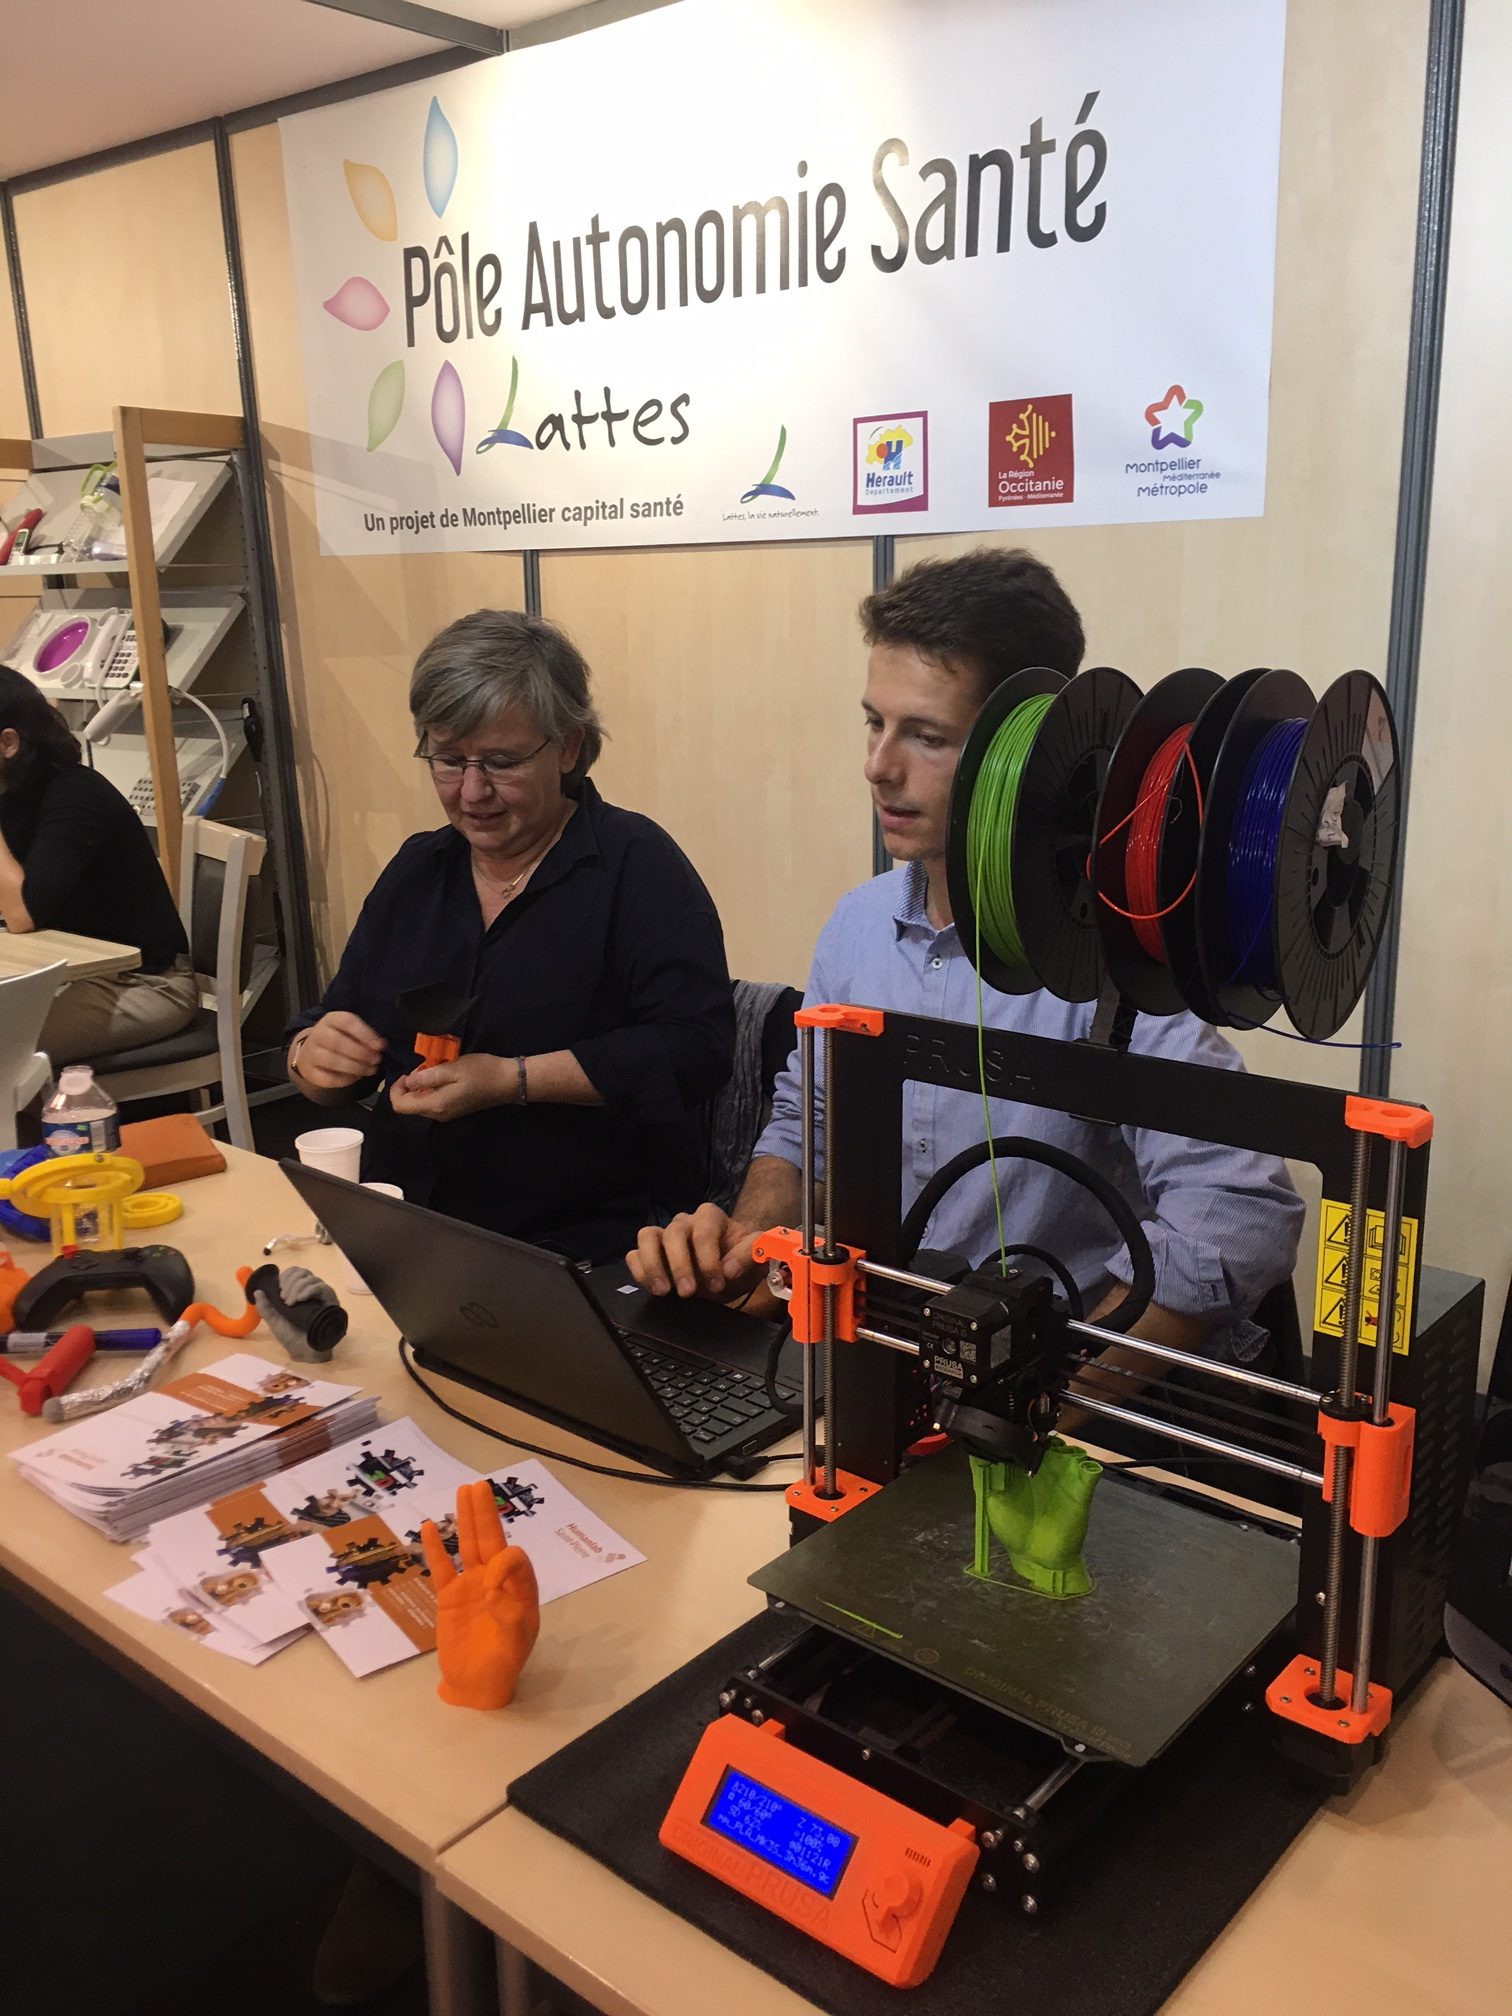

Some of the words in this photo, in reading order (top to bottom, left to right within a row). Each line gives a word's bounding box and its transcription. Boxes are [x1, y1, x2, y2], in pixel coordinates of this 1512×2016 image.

[402, 231, 503, 349] Pôle
[521, 159, 847, 331] Autonomie
[870, 89, 1108, 274] Santé
[475, 354, 692, 455] Lattes
[998, 471, 1008, 479] La
[1008, 469, 1035, 480] Région
[998, 476, 1064, 494] Occitanie
[363, 512, 386, 532] Un
[389, 509, 437, 536] projet
[439, 507, 460, 529] de
[461, 501, 556, 531] Montpellier
[560, 497, 625, 526] capital
[629, 493, 685, 519] santé
[756, 510, 768, 519] vie
[934, 1355, 963, 1371] PRUSA
